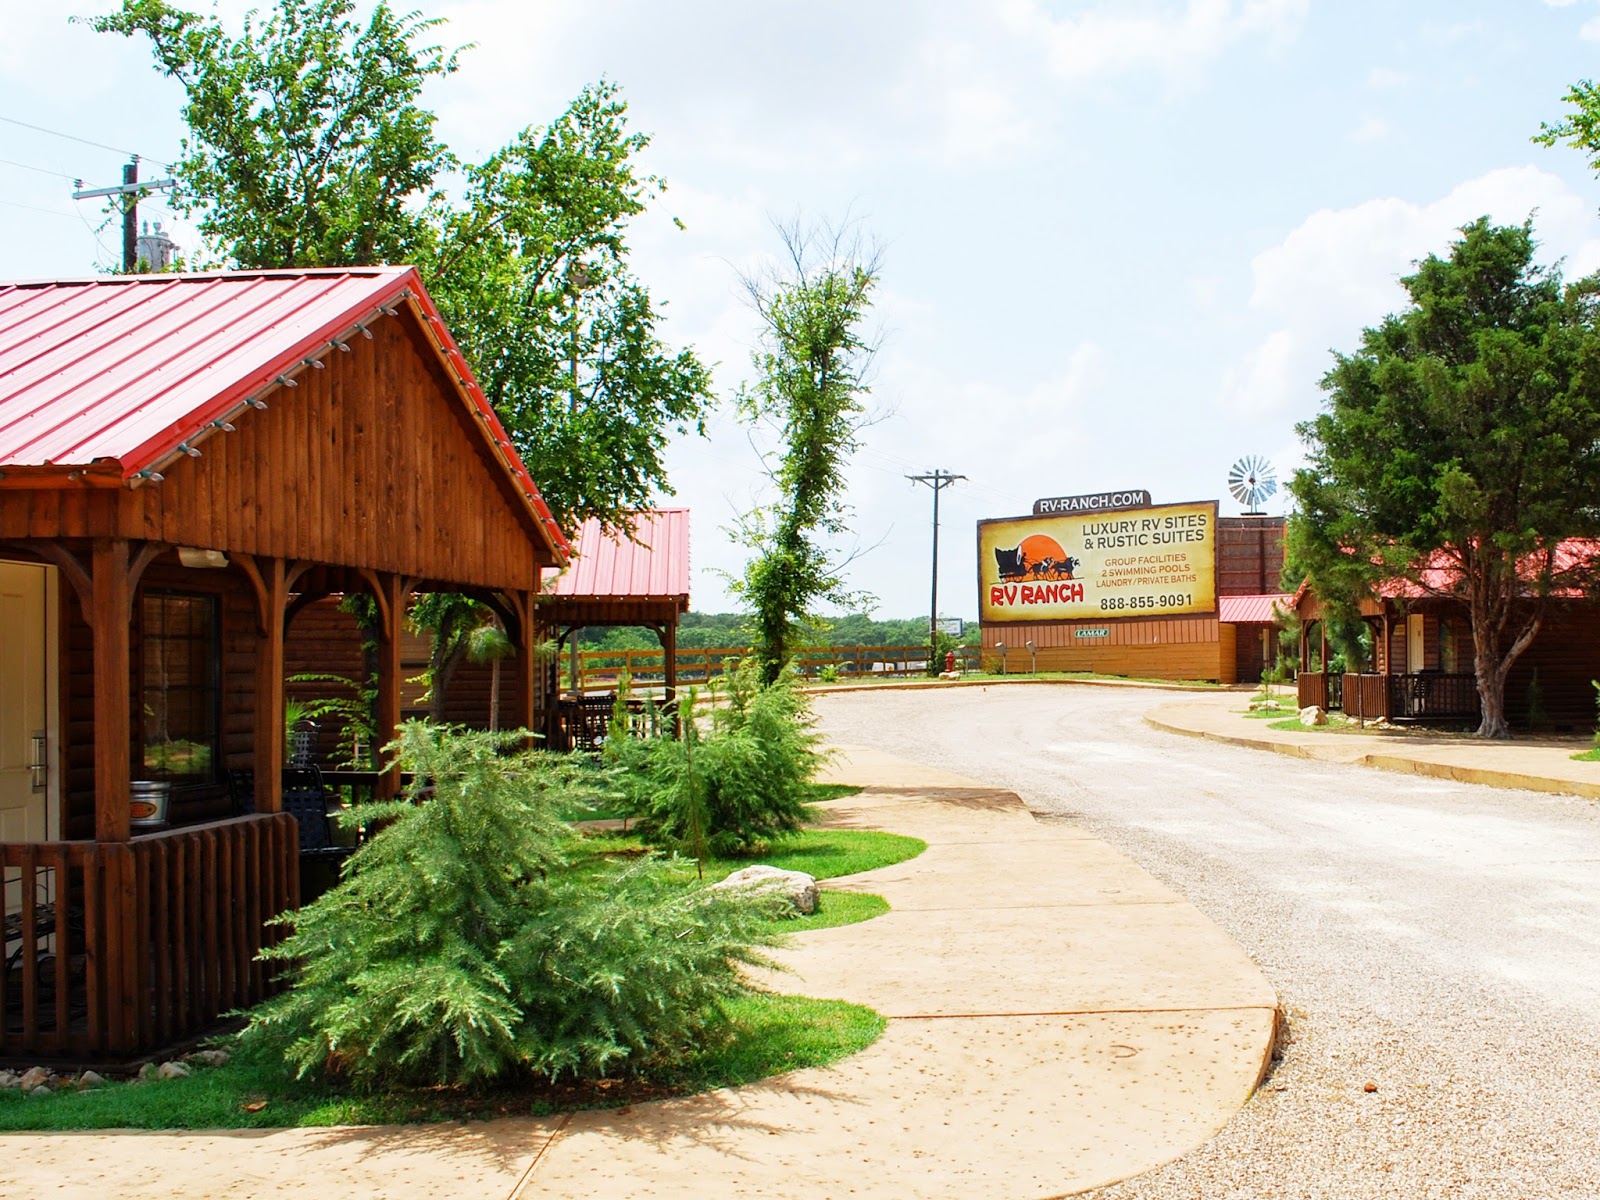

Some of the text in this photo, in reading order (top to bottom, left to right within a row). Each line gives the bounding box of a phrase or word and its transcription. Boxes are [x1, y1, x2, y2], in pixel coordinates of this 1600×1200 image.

[1040, 492, 1144, 513] RV-RANCH.COM
[1083, 514, 1207, 536] LUXURY RV SITES
[1084, 529, 1205, 550] & RUSTIC SUITES
[1105, 553, 1187, 567] GROUP FACILITIES
[1101, 563, 1190, 577] 2 SWIMMING POOLS
[1171, 574, 1197, 583] BATHS
[990, 582, 1084, 606] RV RANCH
[1100, 594, 1192, 610] 888-855-9091
[1077, 630, 1106, 638] LAMAR
